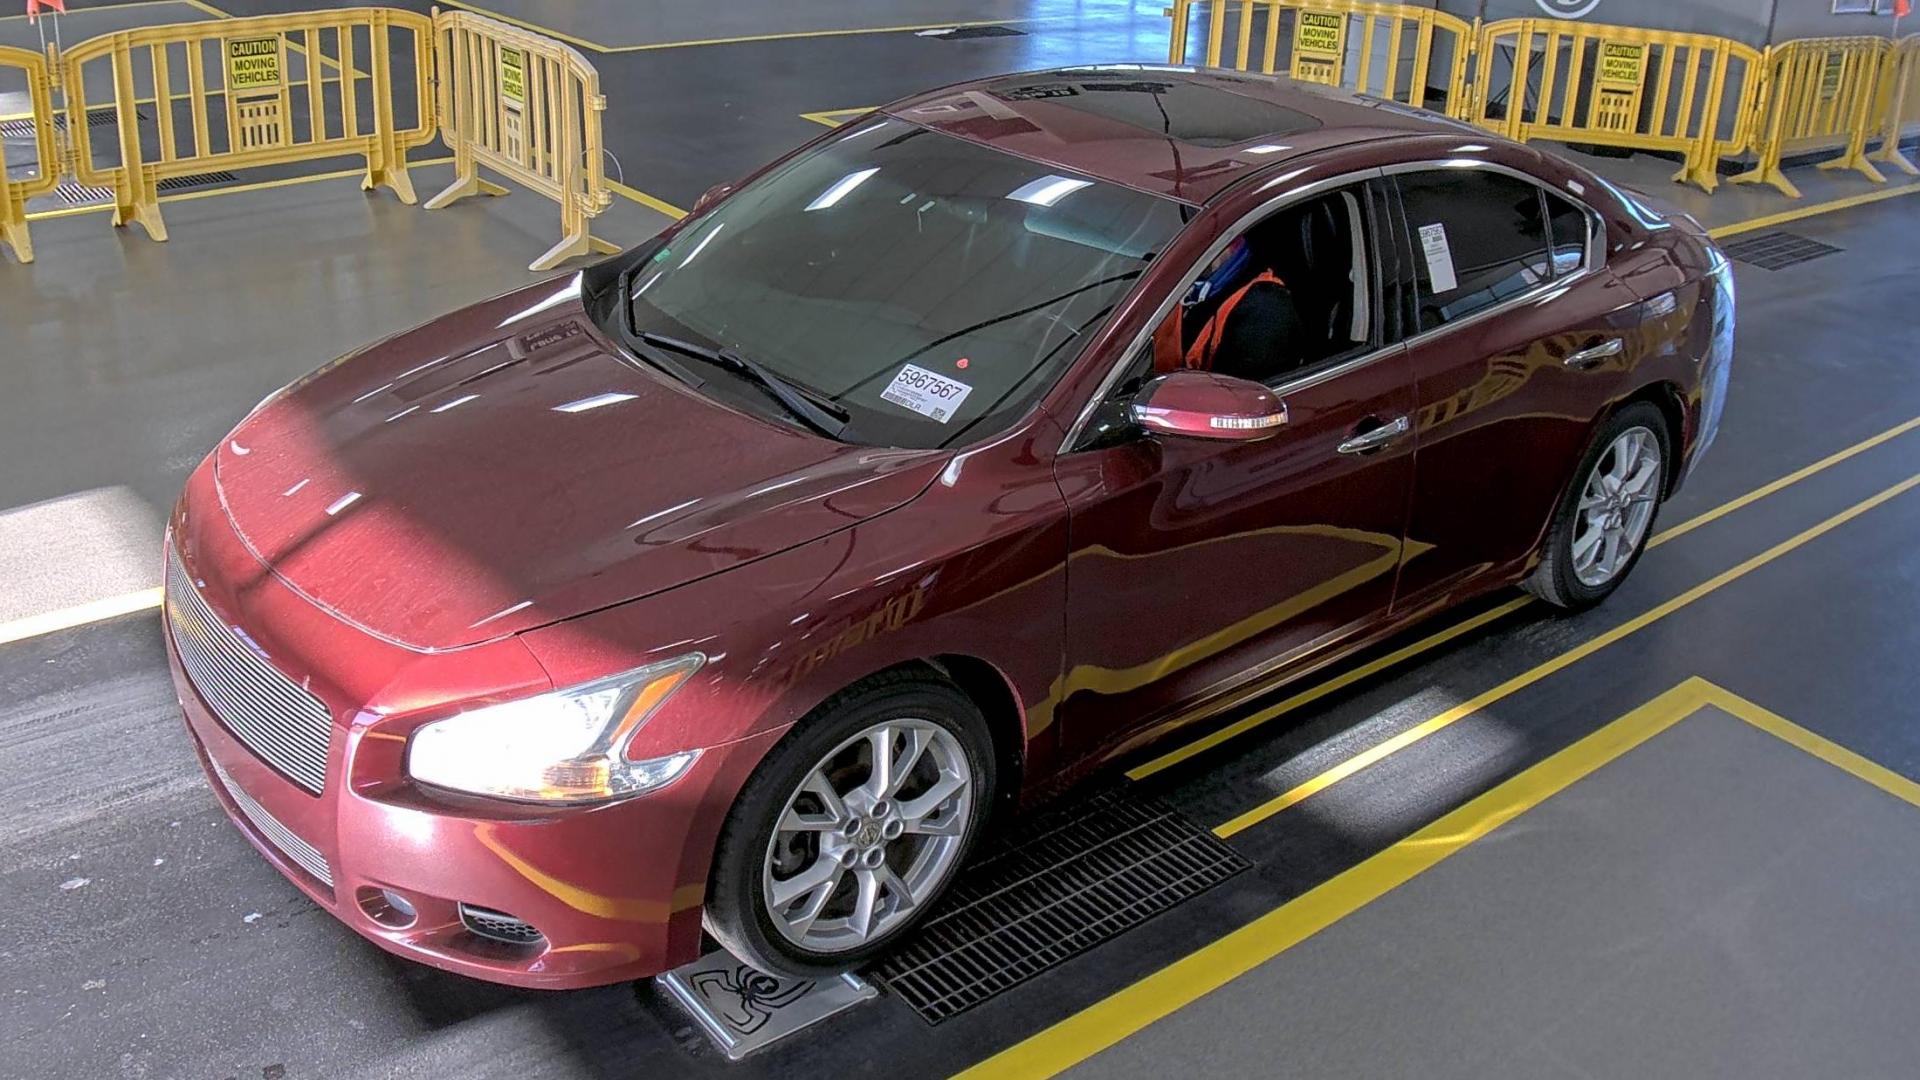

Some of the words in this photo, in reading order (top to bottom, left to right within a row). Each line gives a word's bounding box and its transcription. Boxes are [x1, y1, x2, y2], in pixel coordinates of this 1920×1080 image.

[1303, 14, 1339, 27] CAUTION
[1303, 27, 1336, 40] MOVING
[231, 40, 276, 56] CAUTION
[1300, 38, 1338, 50] VEHICLES
[1606, 45, 1641, 57] CAUTION
[234, 57, 275, 71] MOVING
[1606, 59, 1638, 70] MOVING
[232, 70, 279, 84] VEHICLES
[1602, 69, 1638, 80] VEHICLES
[898, 368, 962, 401] 5967567
